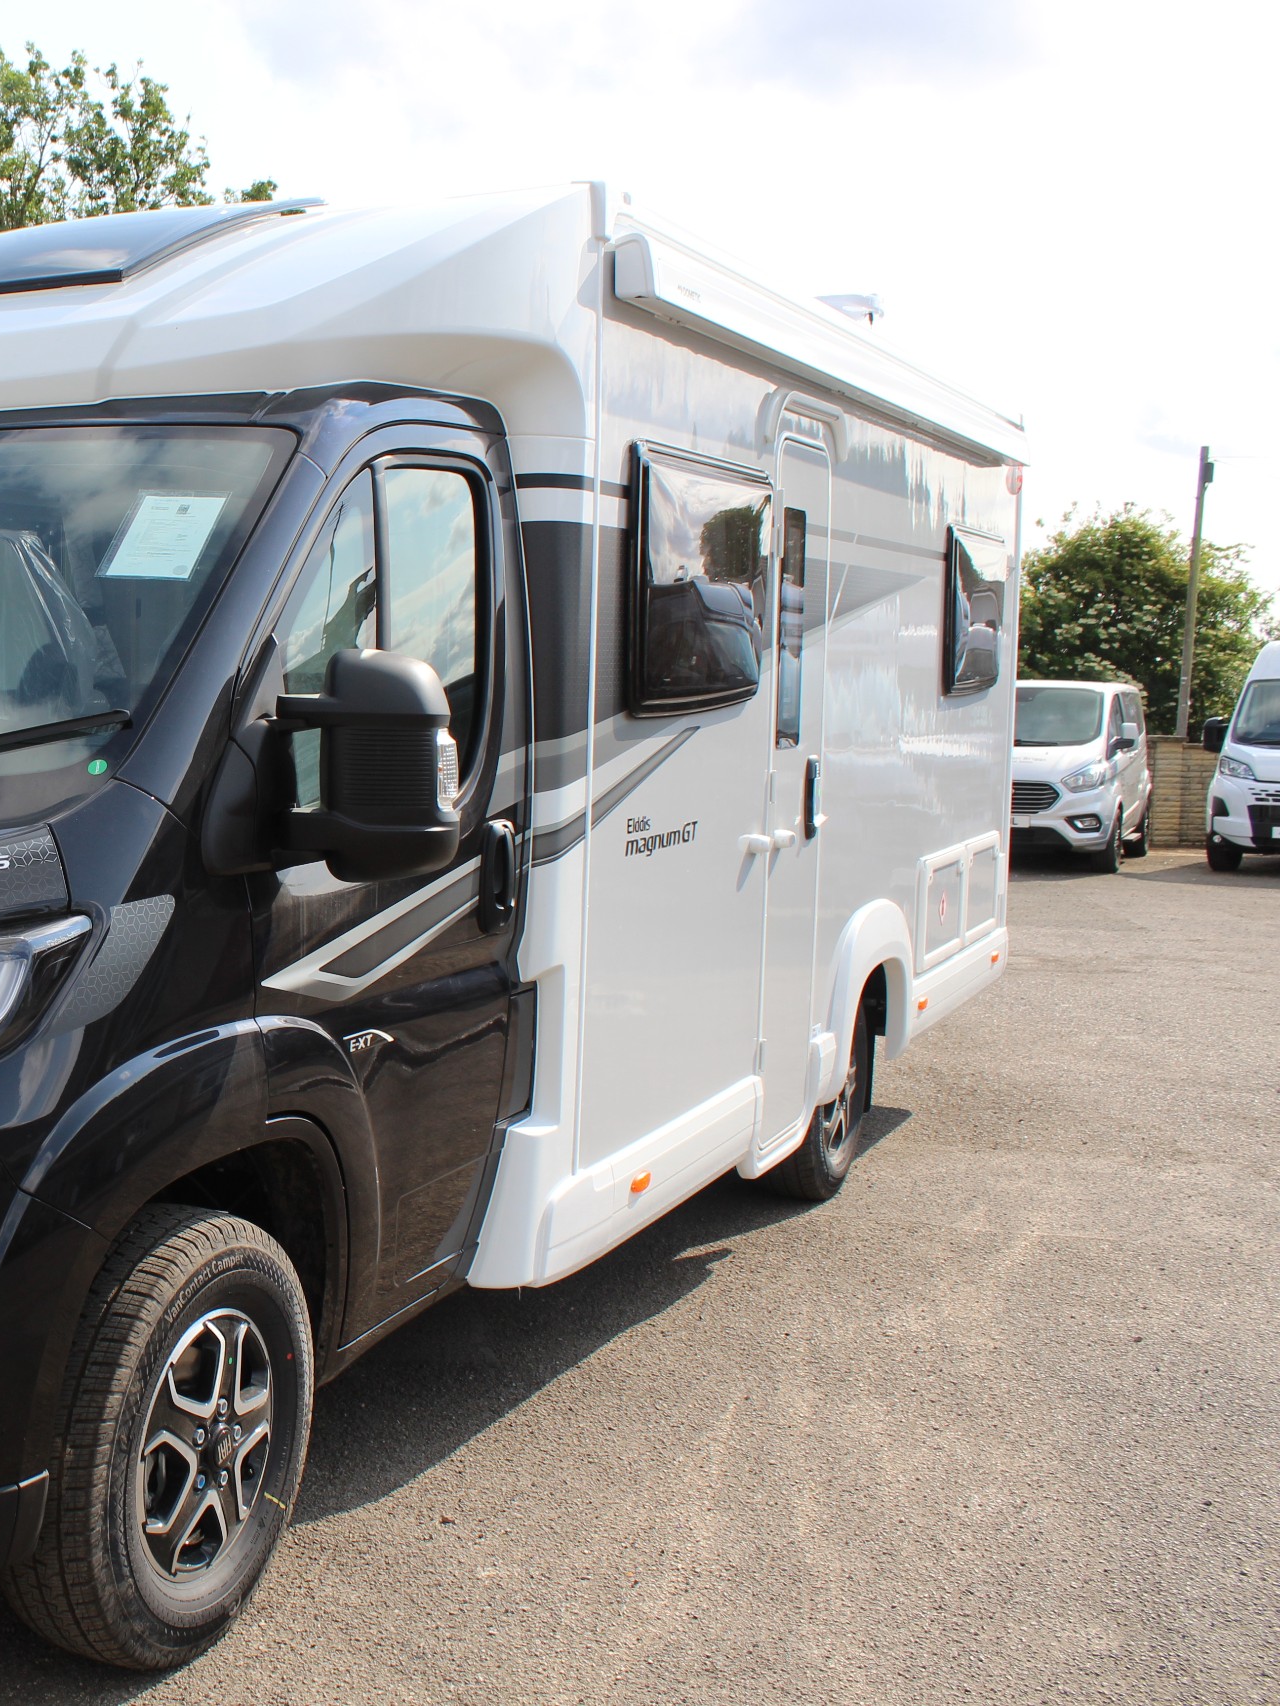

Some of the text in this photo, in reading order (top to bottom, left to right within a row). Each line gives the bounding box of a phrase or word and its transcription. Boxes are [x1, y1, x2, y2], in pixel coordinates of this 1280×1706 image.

[625, 820, 698, 857] magnum GT
[627, 815, 651, 834] Elddis
[349, 1033, 373, 1053] E-XT
[164, 1253, 245, 1323] VanContact Camper
